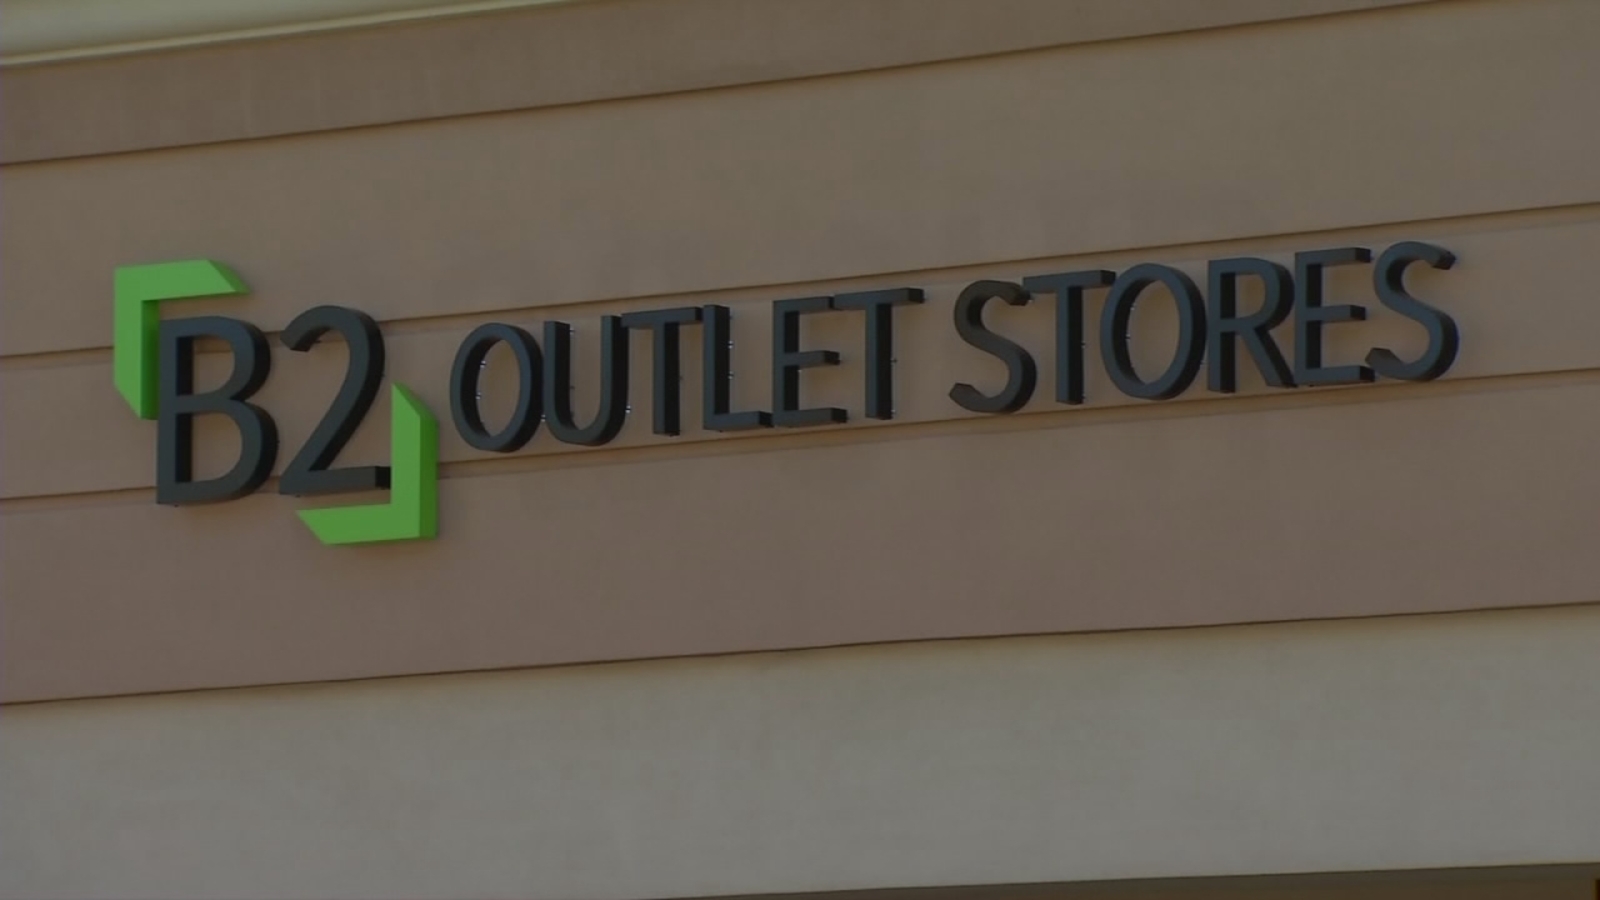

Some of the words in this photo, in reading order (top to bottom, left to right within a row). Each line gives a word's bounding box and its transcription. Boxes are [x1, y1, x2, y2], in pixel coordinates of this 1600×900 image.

[156, 305, 391, 506] B2
[450, 287, 924, 453] OUTLET
[948, 241, 1459, 414] STORES
